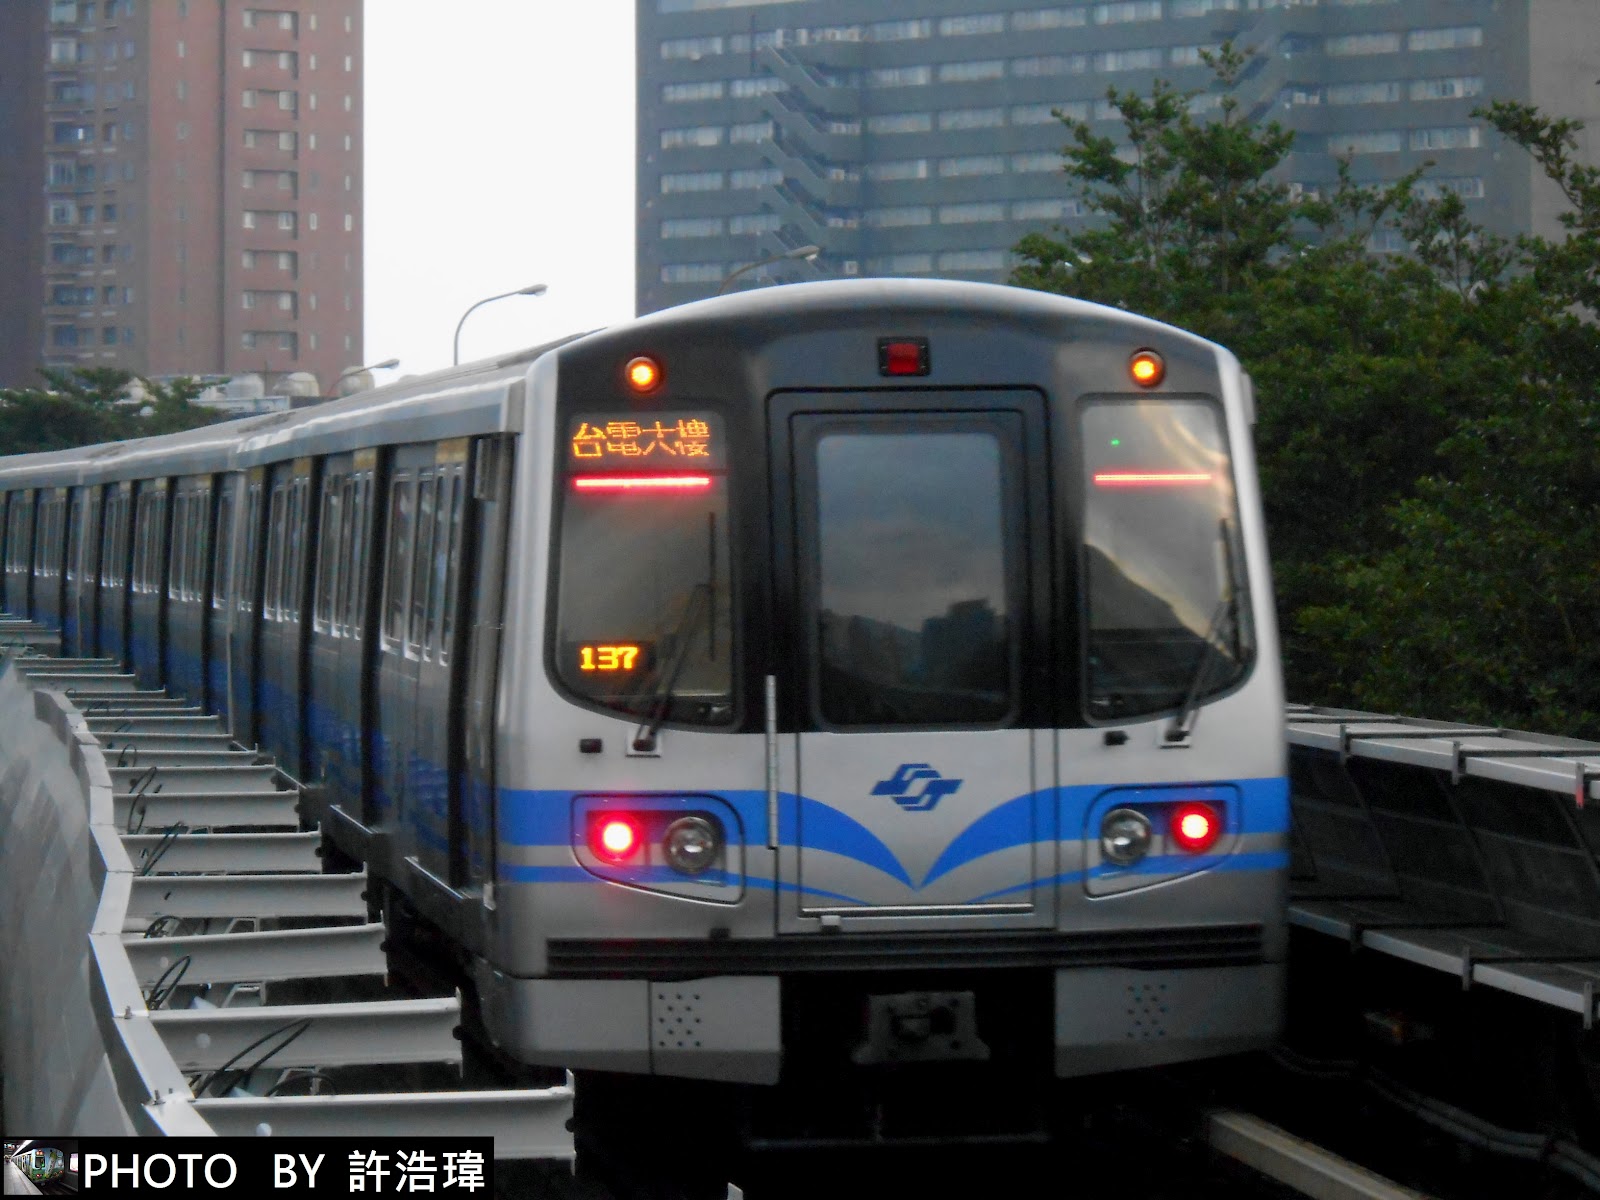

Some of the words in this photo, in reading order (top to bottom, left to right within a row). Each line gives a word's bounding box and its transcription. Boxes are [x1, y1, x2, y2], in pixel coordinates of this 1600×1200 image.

[572, 418, 711, 457] 台電大樓
[580, 646, 639, 670] 137
